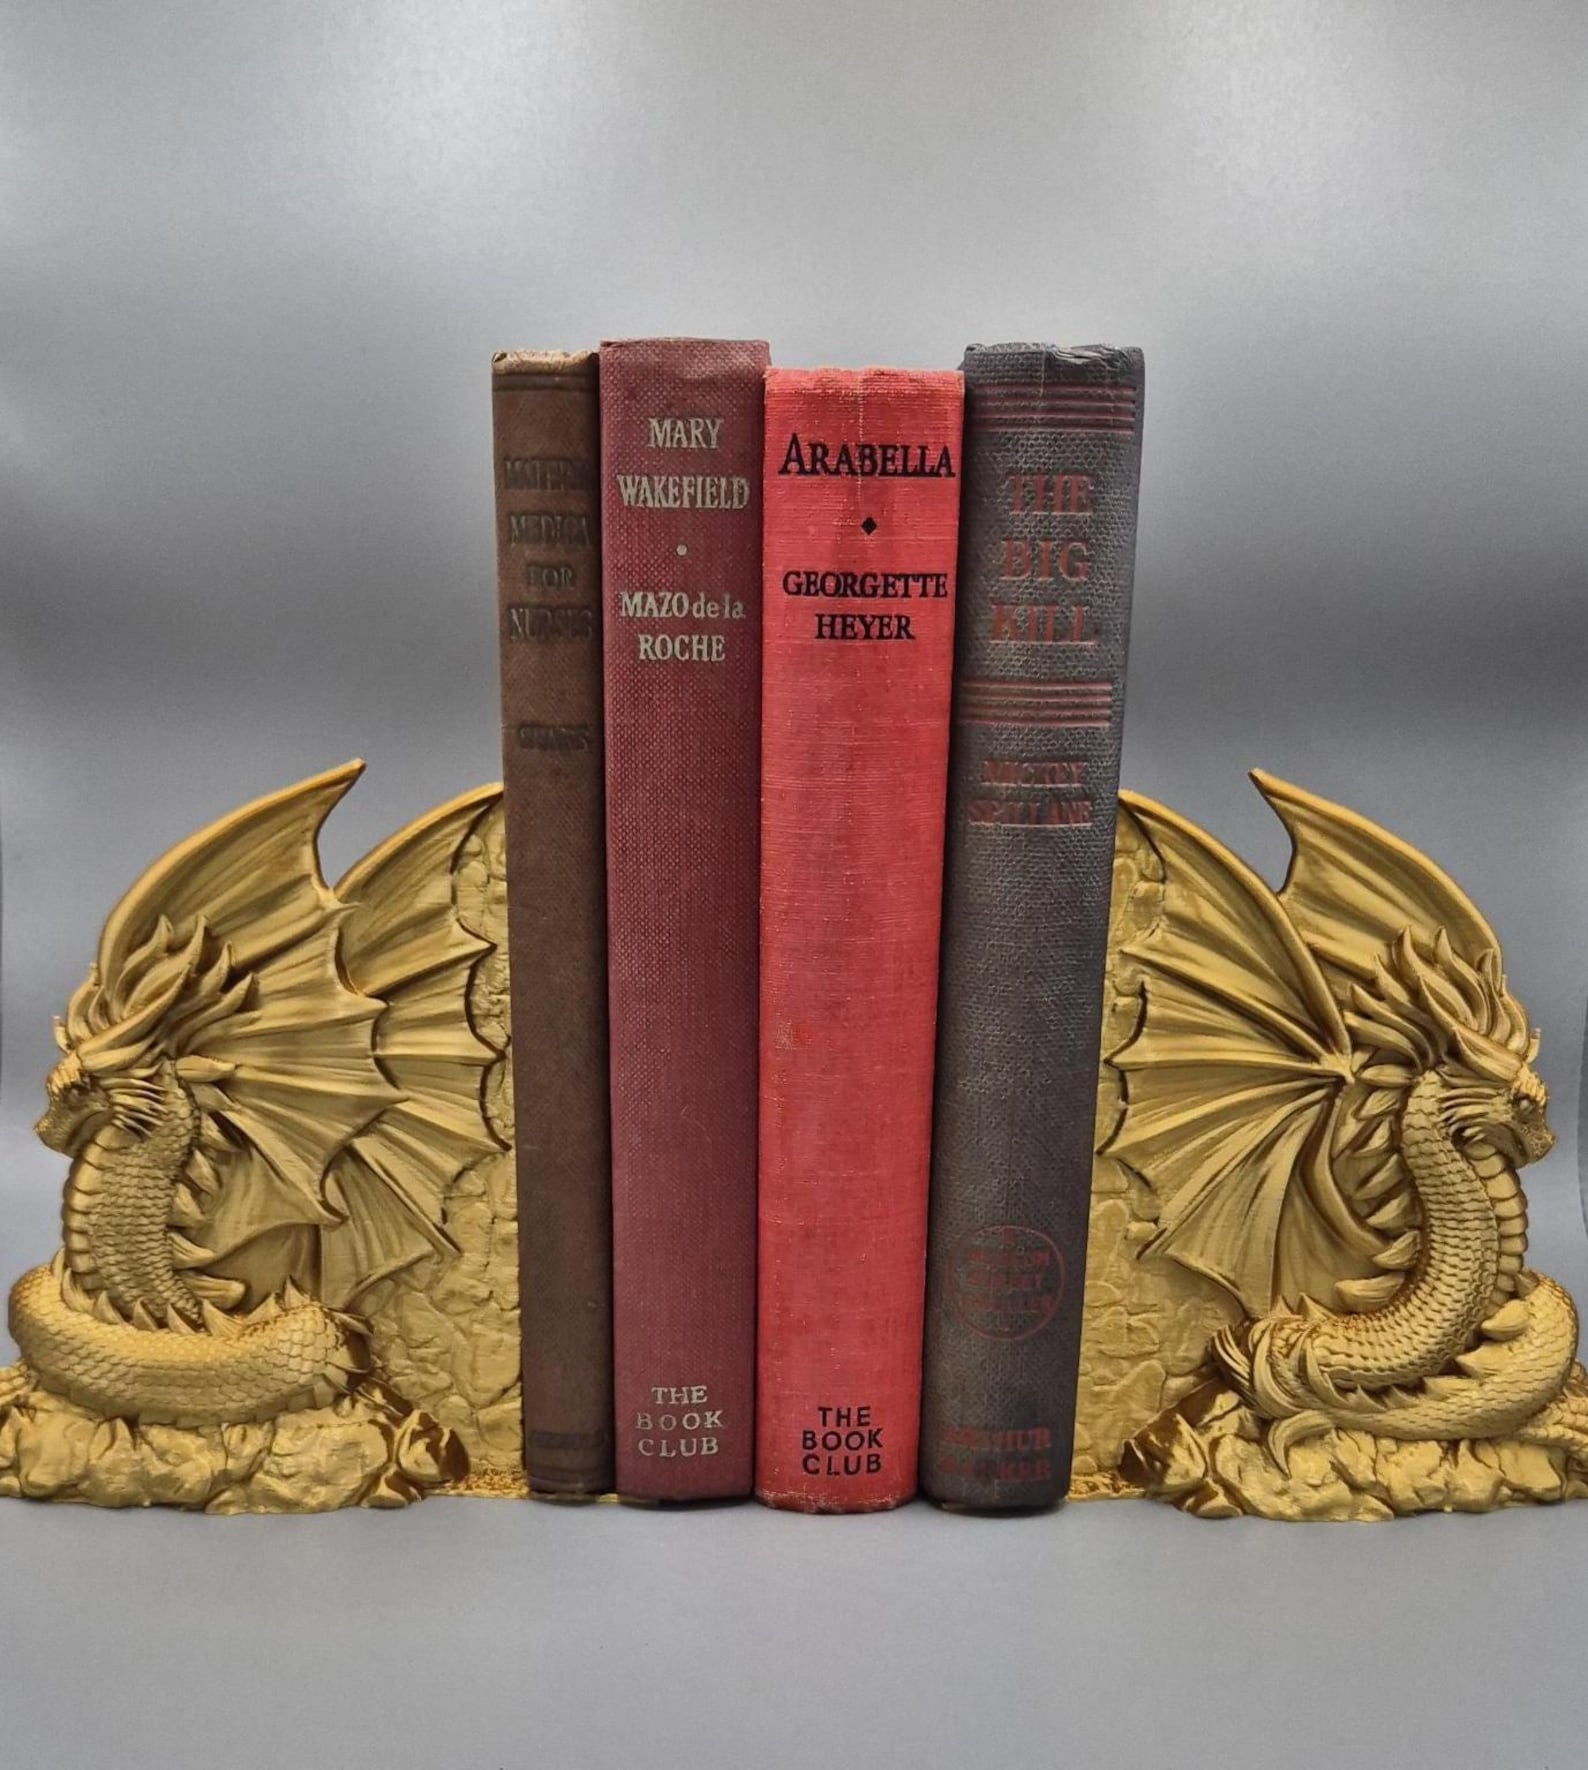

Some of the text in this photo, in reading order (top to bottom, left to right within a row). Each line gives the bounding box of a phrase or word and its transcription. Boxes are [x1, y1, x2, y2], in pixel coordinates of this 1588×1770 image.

[647, 417, 724, 450] MARY
[777, 433, 957, 478] ARABELLA
[616, 474, 750, 510] WAKEFIELD
[1006, 473, 1096, 516] THE
[1000, 538, 1090, 580] BIG
[782, 569, 948, 599] GEORGETTE
[619, 591, 690, 619] MAZO
[814, 613, 916, 641] HEYER
[989, 603, 1096, 645] KILL
[638, 634, 727, 662] ROCHE
[651, 1385, 709, 1406] THE
[635, 1410, 723, 1431] BOOK
[817, 1406, 872, 1428] THE
[638, 1436, 720, 1458] CLUB
[801, 1429, 884, 1452] BOOK
[801, 1453, 883, 1476] CLUB
